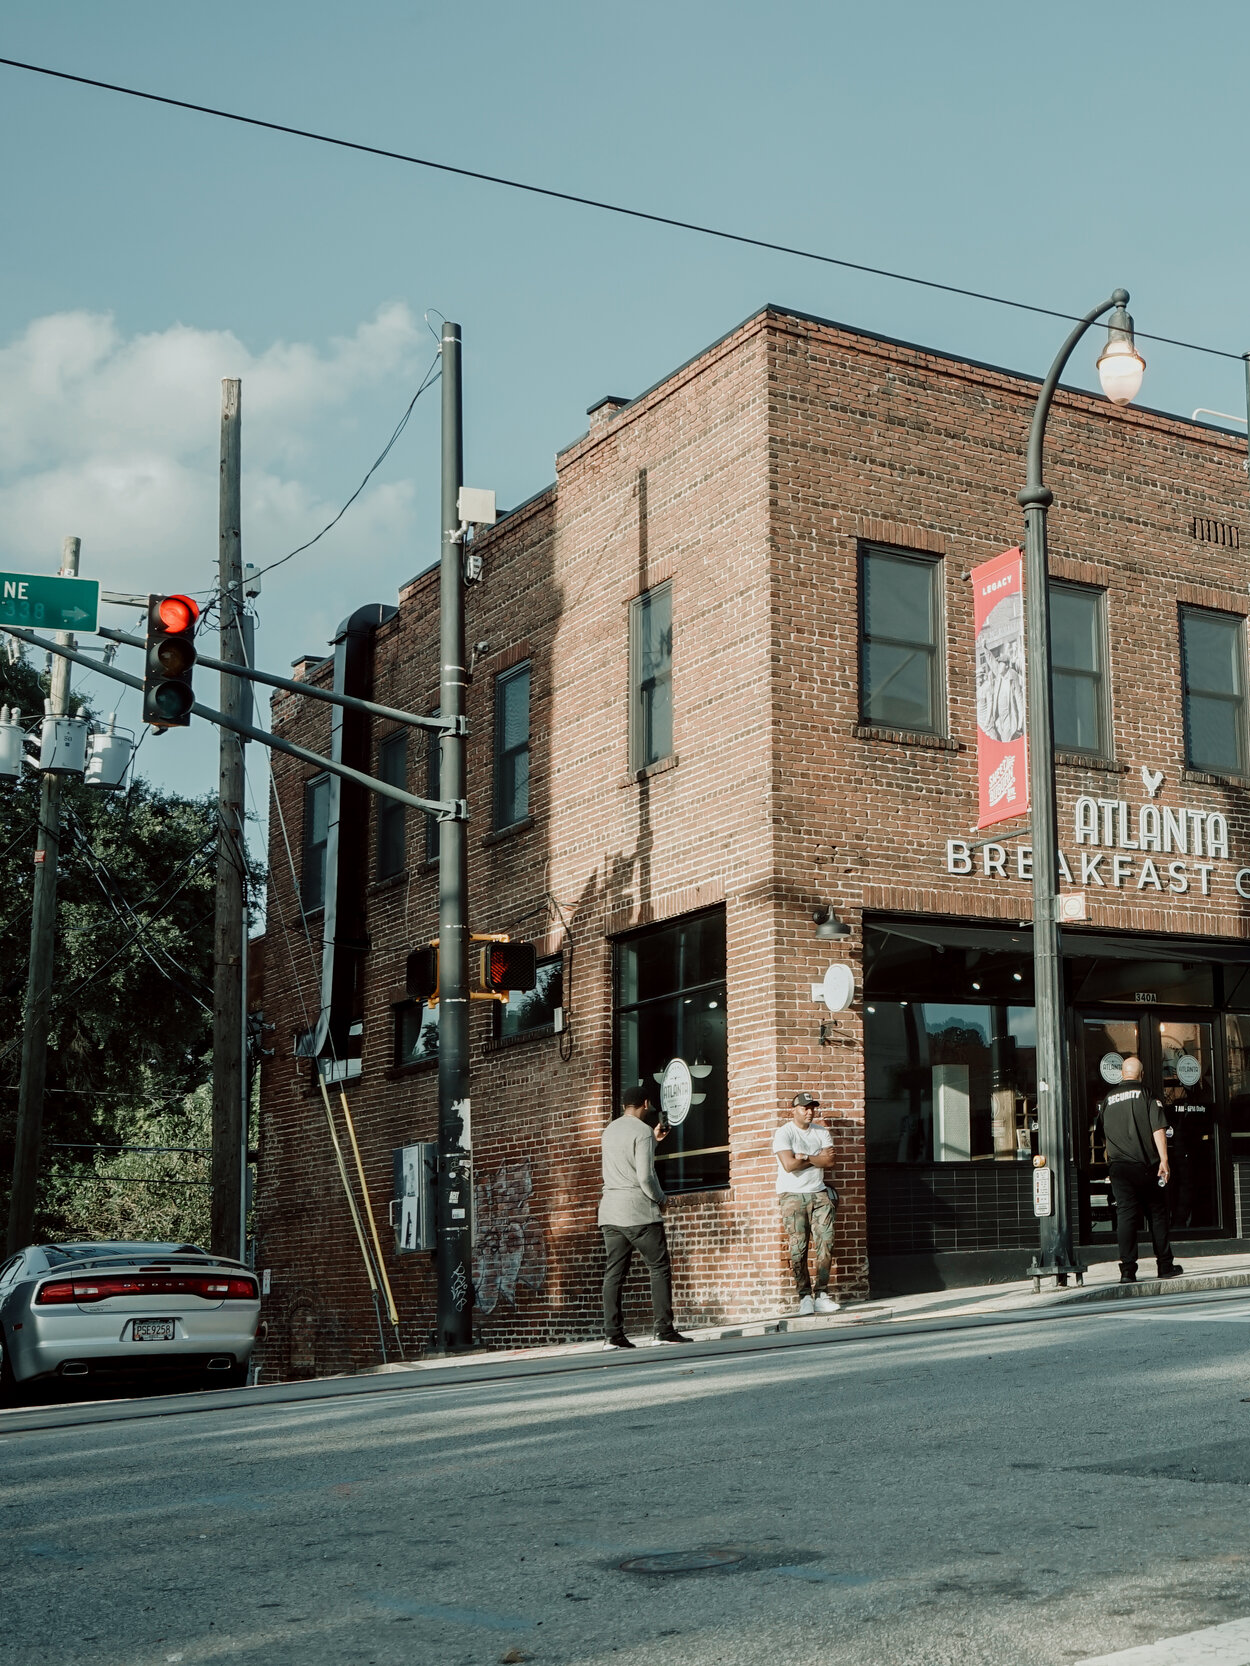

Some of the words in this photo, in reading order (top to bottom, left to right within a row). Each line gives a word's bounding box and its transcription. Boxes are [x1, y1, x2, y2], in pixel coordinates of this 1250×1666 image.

[3, 581, 29, 600] NE
[982, 574, 1012, 596] LEGACY
[1075, 795, 1229, 859] ATLANTA
[946, 839, 1213, 896] BREAKFAST
[1136, 993, 1156, 1002] 340A
[1107, 1089, 1141, 1106] SECURITY
[137, 1325, 171, 1335] PSE9258
